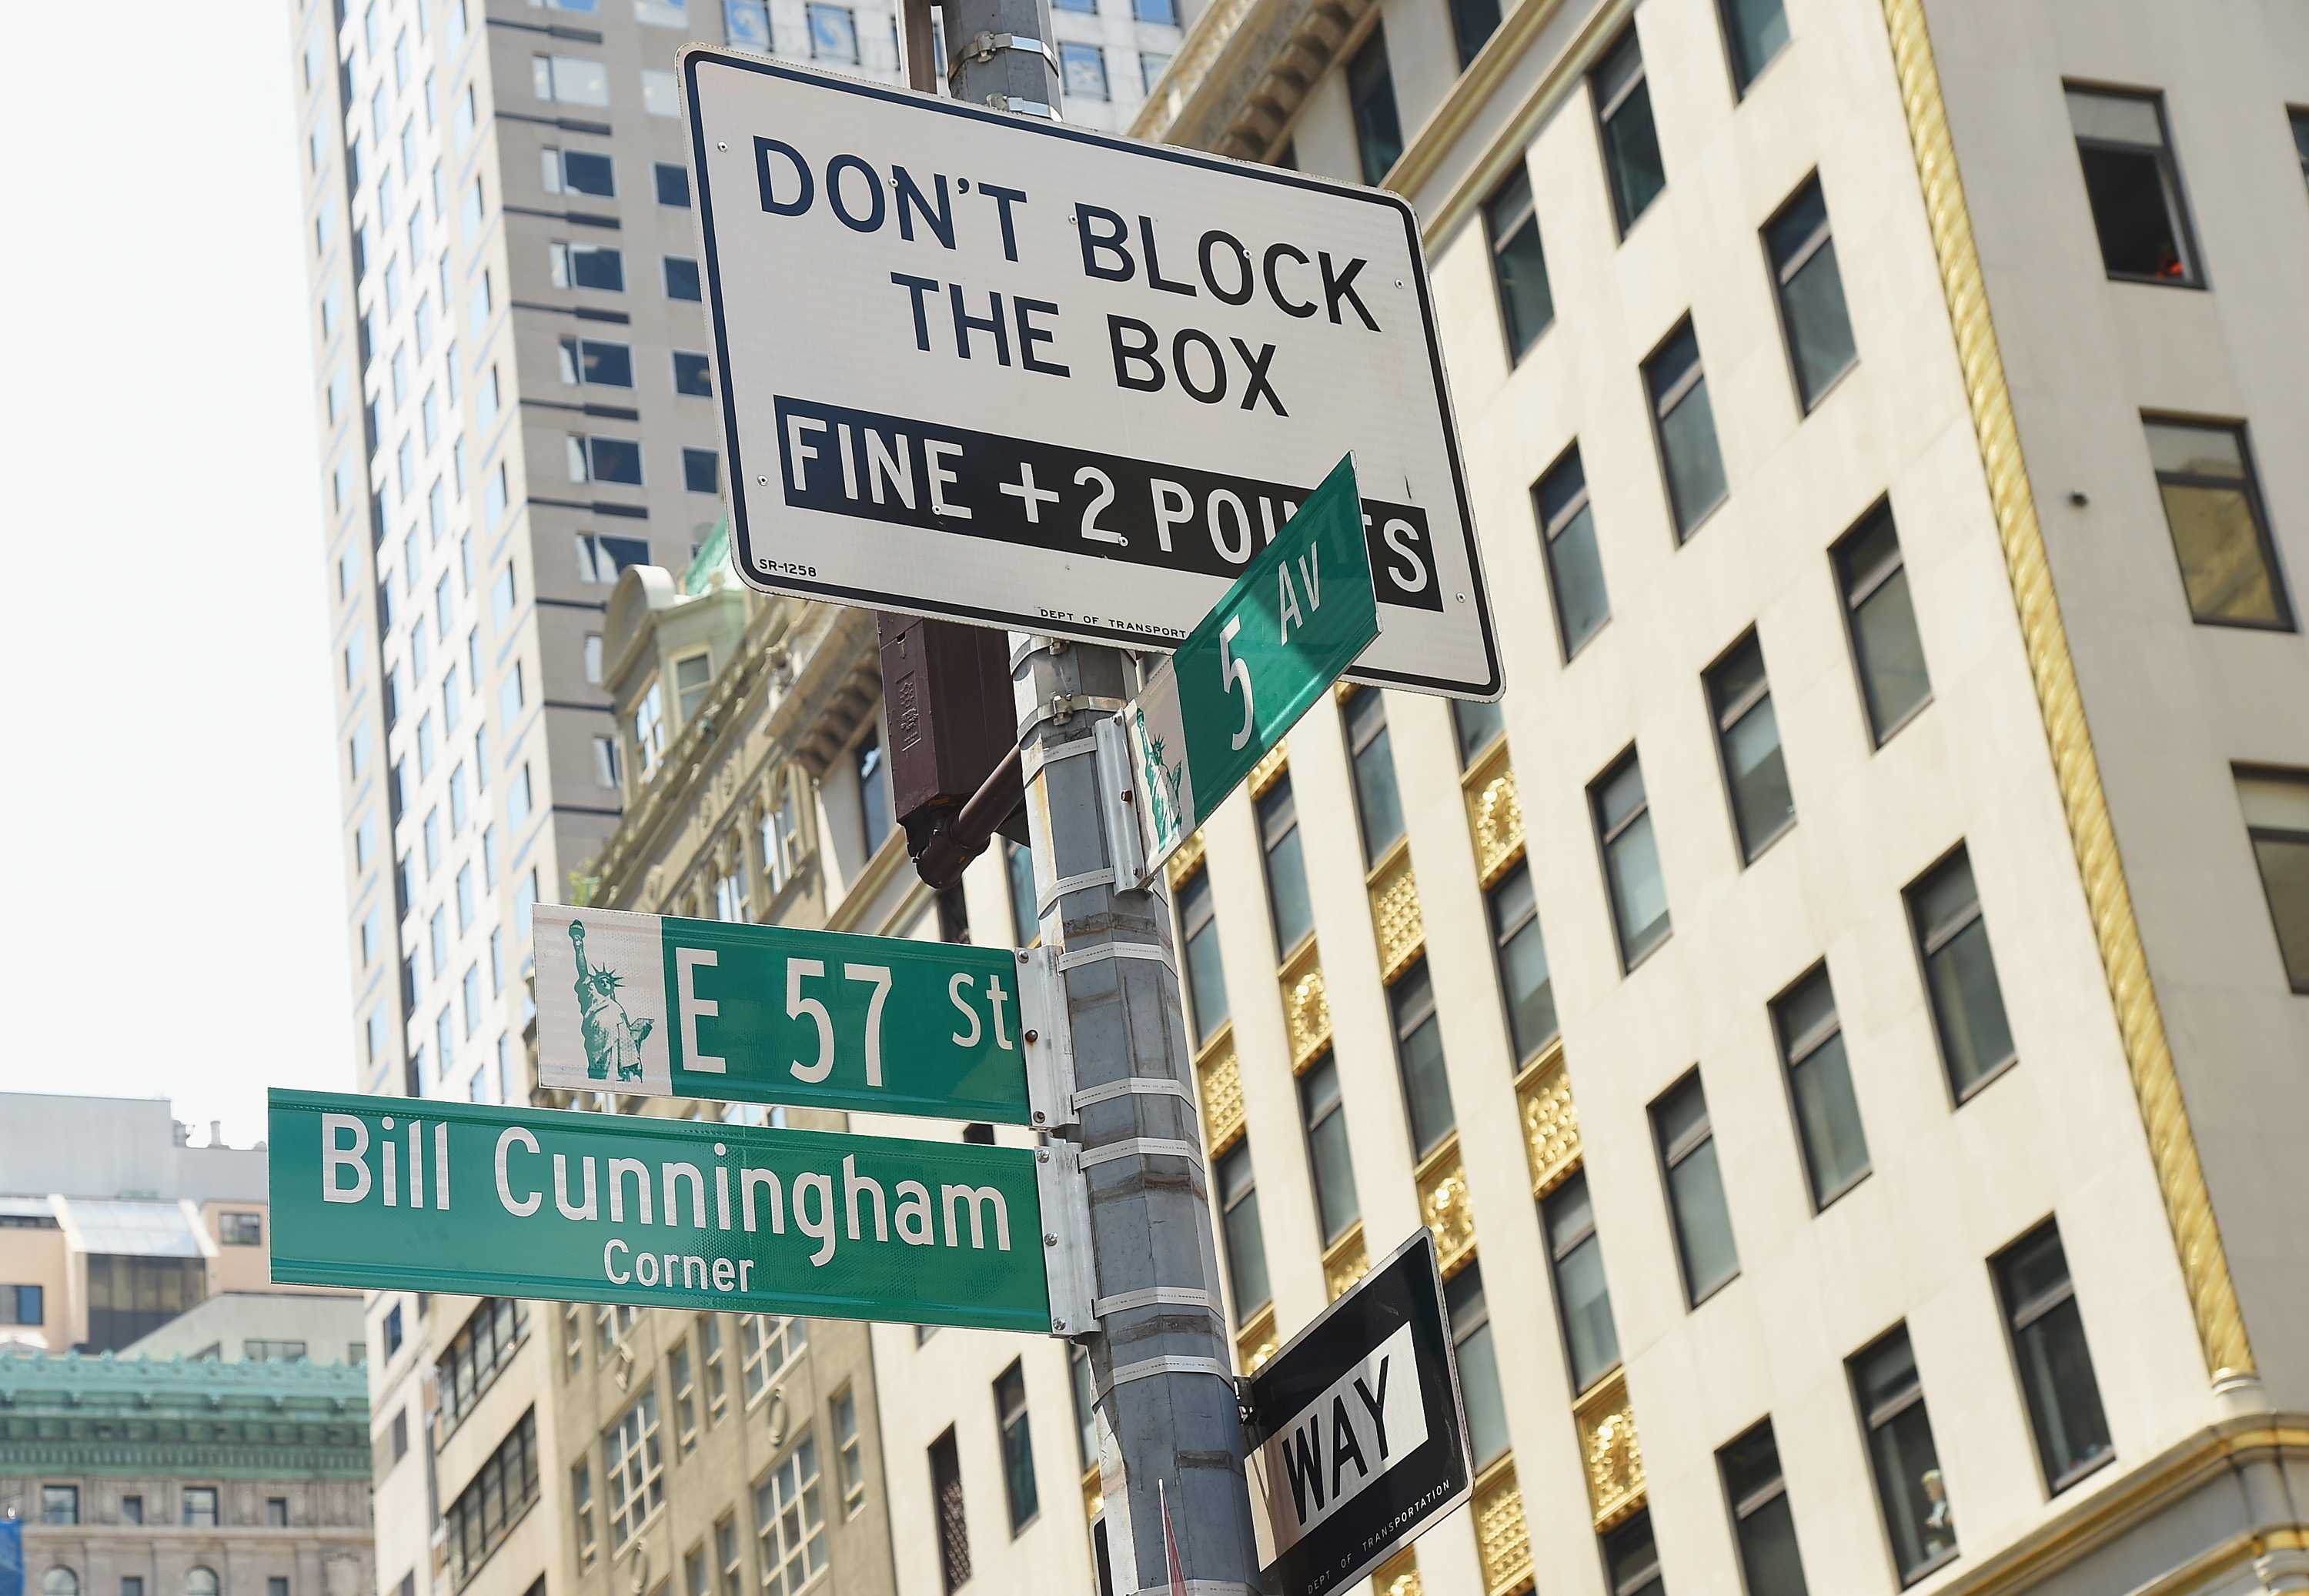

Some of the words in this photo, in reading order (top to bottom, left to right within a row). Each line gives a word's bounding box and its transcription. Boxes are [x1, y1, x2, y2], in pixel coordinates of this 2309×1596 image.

[754, 135, 1028, 262] DON'T
[1074, 202, 1382, 332] BLOCK
[891, 272, 1071, 378] THE
[1106, 313, 1289, 417] BOX
[759, 559, 817, 577] SR-1258
[786, 414, 972, 519] FINE
[1150, 477, 1428, 593] POIS
[1040, 608, 1074, 621] DEPT
[1083, 615, 1099, 625] OF
[1108, 619, 1187, 639] TRANSPORT
[1218, 613, 1254, 751] 5
[1278, 540, 1322, 646] AV
[675, 947, 727, 1073] E
[785, 957, 893, 1087] 57
[947, 971, 1014, 1051] St
[321, 1112, 450, 1211] Bill
[493, 1126, 1011, 1267] Cunningham
[603, 1237, 754, 1293] Corner
[1281, 1354, 1389, 1528] WAY
[1307, 1570, 1331, 1594] DEPT
[1341, 1553, 1352, 1568] OF
[1362, 1479, 1450, 1552] TRANSPORTATION
